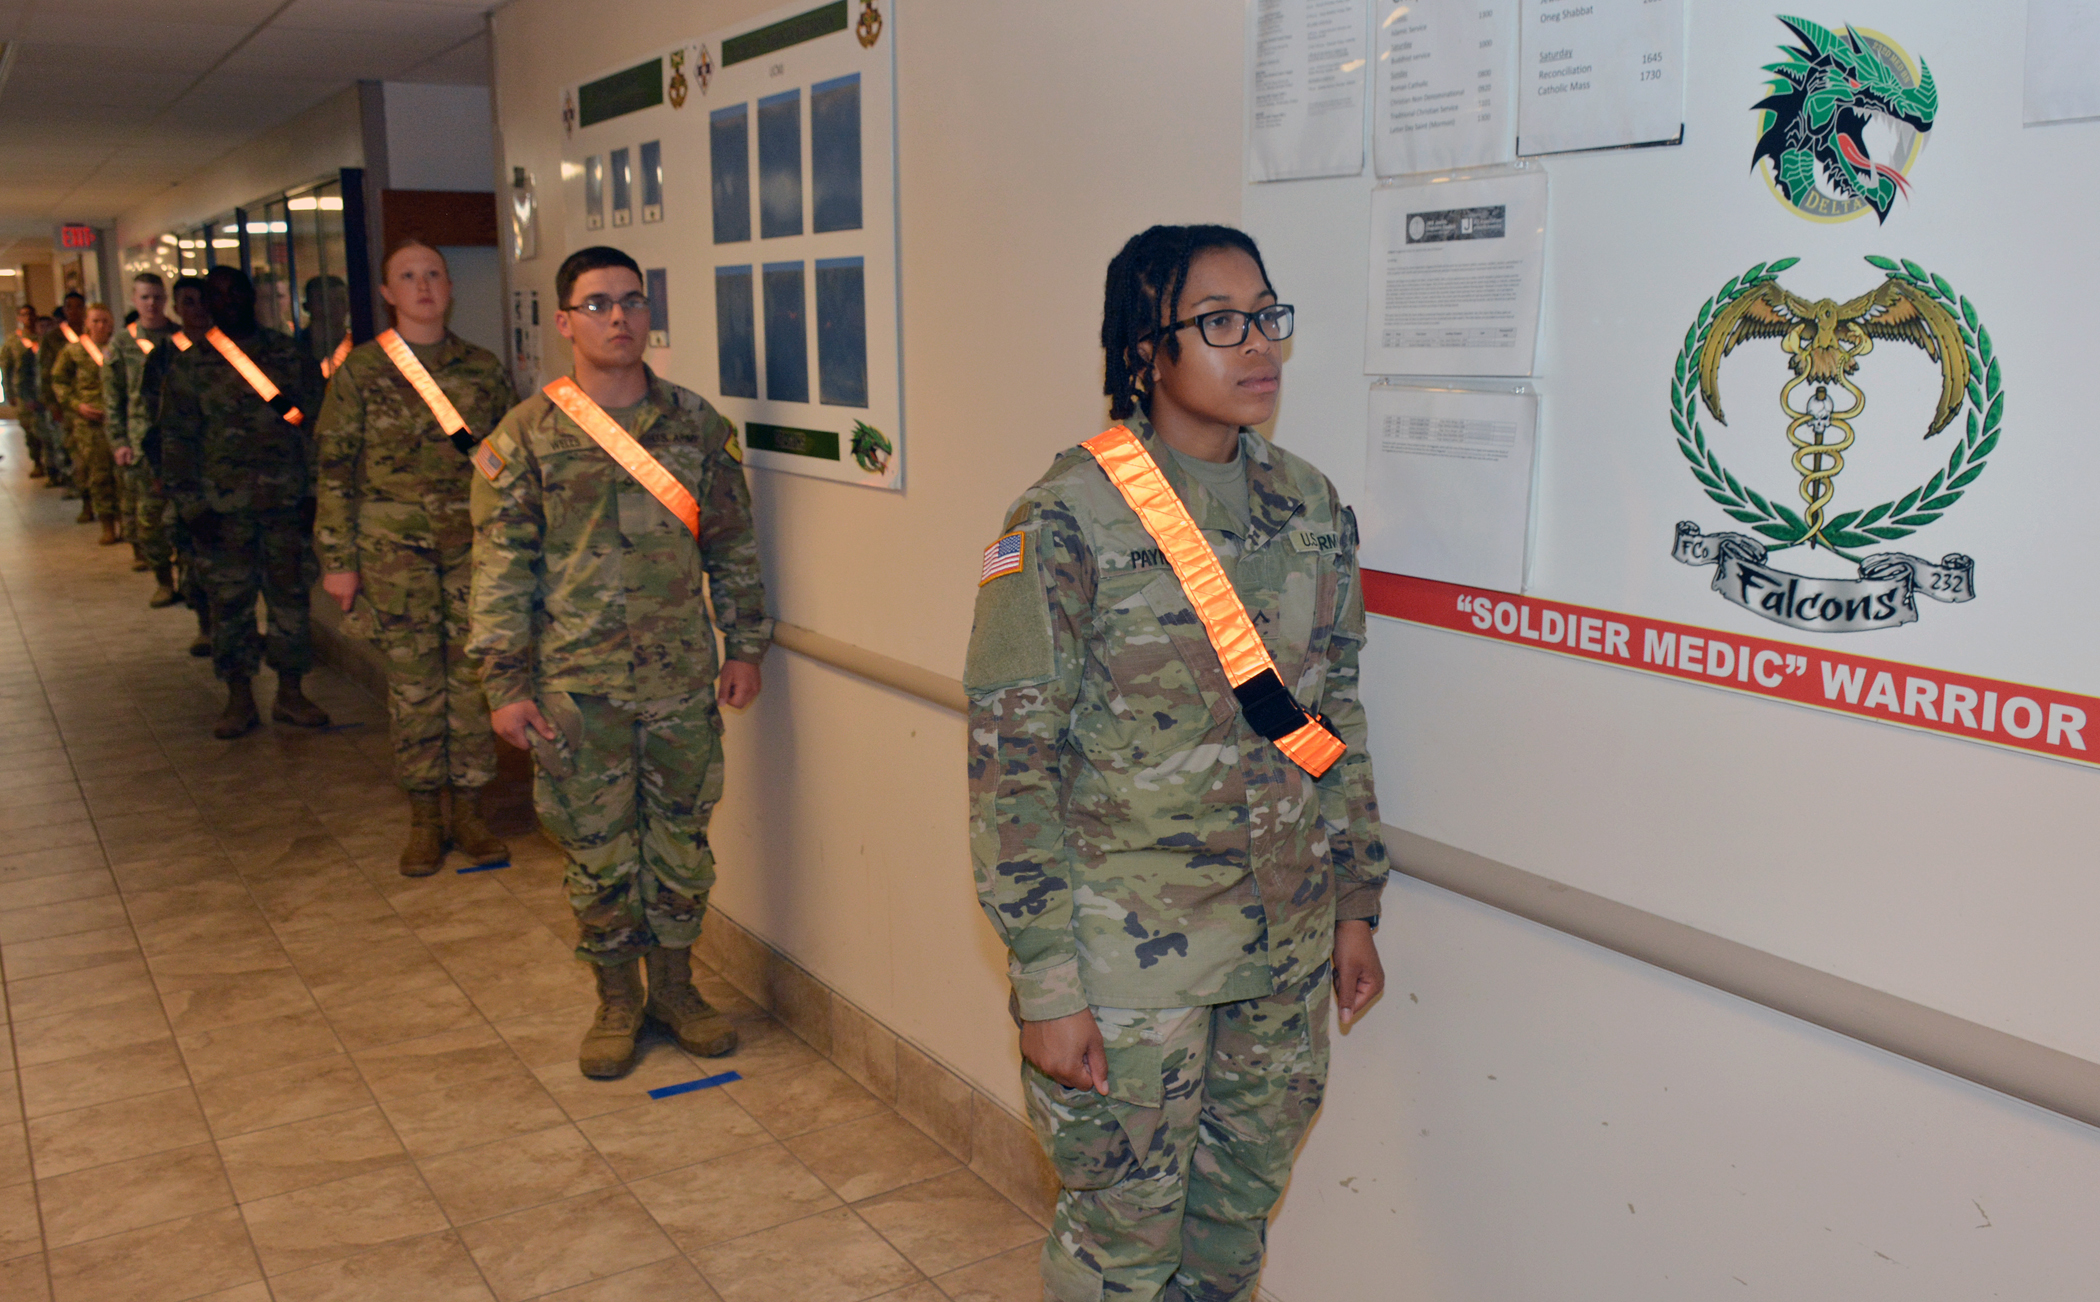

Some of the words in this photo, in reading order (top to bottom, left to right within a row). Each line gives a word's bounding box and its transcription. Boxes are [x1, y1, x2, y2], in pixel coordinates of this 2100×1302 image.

[1540, 13, 1561, 23] Oneg
[1562, 5, 1593, 19] Shabbat
[1539, 48, 1573, 63] Saturday
[1539, 64, 1592, 80] Reconciliation
[1642, 52, 1663, 64] 1645
[1890, 53, 1904, 71] MED
[1538, 82, 1568, 96] Catholic
[1570, 81, 1591, 92] Mass
[1640, 69, 1662, 81] 1730
[1805, 190, 1863, 215] DELTA
[61, 226, 91, 248] EXIT
[1736, 561, 1899, 622] Falcons
[1931, 572, 1963, 593] 232
[1456, 593, 1631, 659] “SOLDIER
[1643, 627, 1808, 689] MEDIC”
[1820, 660, 2087, 751] WARRIOR
